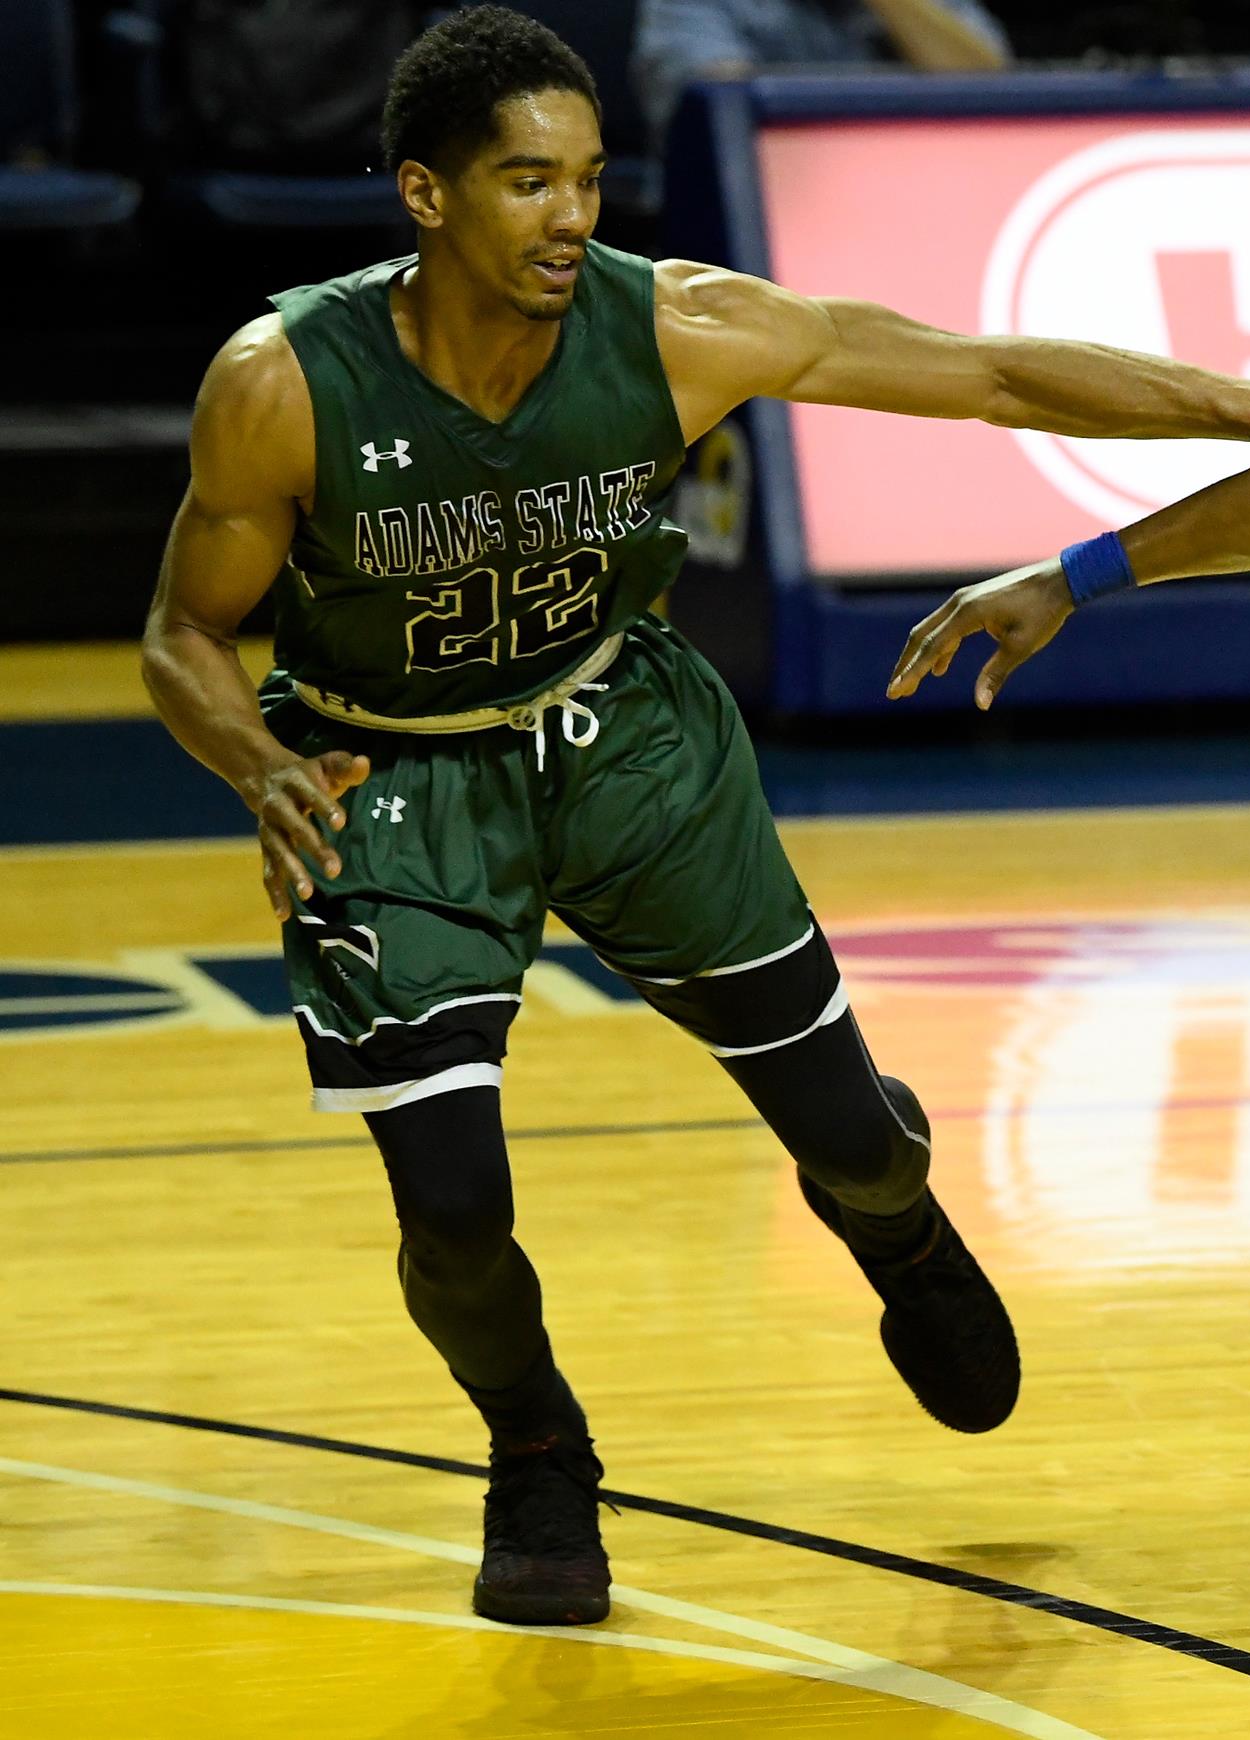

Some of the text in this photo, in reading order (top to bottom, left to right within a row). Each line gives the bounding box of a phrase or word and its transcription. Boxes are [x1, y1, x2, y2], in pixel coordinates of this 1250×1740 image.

[354, 461, 656, 577] ADAMS STATE
[405, 547, 609, 675] 22
